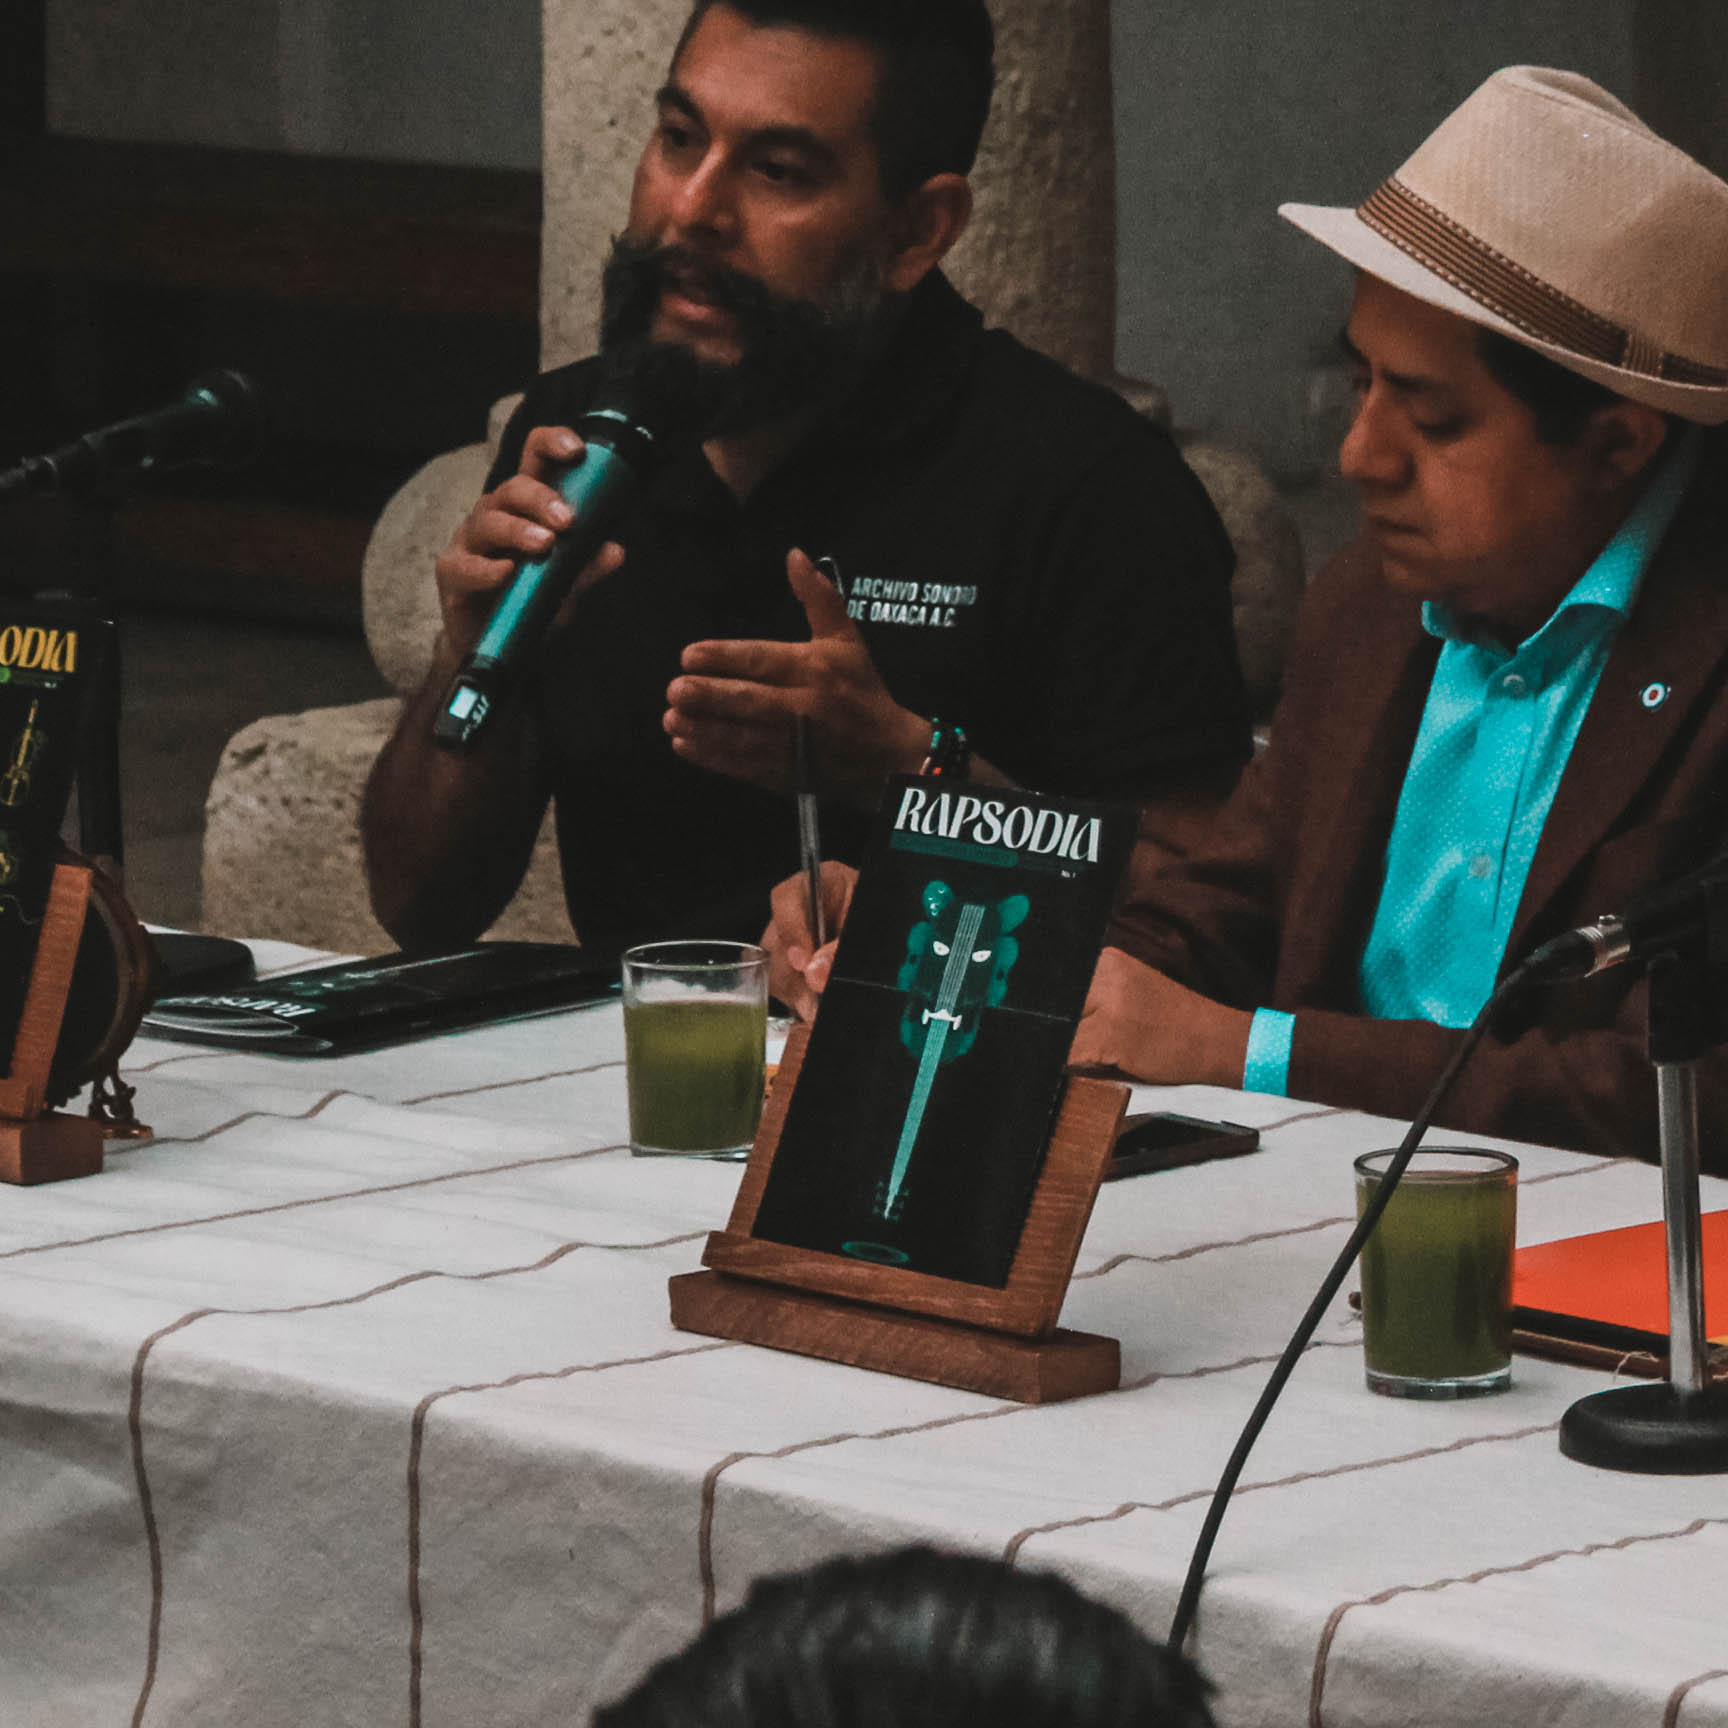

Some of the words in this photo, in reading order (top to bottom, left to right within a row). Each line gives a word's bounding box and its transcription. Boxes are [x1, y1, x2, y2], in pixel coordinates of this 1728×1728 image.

[851, 576, 920, 602] ARCHIVO
[847, 599, 868, 621] DE
[870, 600, 927, 625] OAXACA
[893, 787, 1103, 863] RAPSODIA
